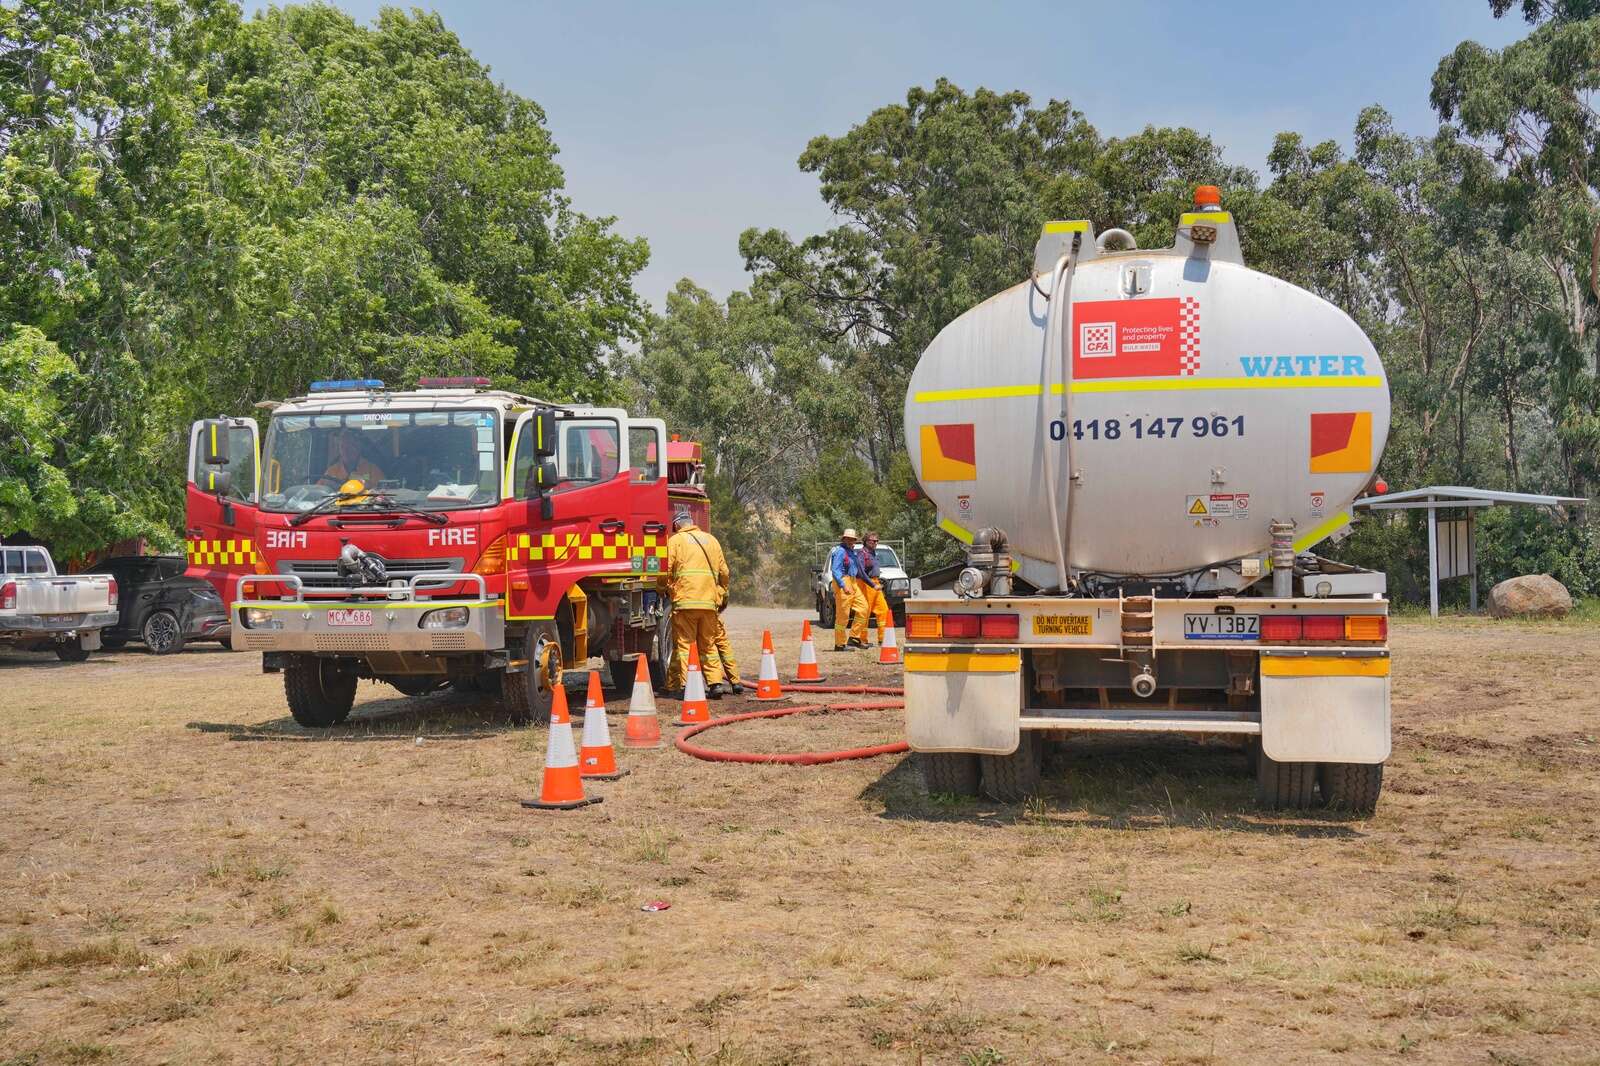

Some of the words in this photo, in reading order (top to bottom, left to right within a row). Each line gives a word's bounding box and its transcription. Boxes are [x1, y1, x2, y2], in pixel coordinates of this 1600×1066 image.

[1122, 326, 1157, 334] Protecting
[1136, 333, 1167, 341] property
[1087, 342, 1109, 351] CFA
[1240, 355, 1366, 377] WATER
[1049, 419, 1121, 441] 0418
[1129, 417, 1184, 439] 147
[1192, 415, 1245, 438] 961
[428, 527, 477, 546] FIRE
[328, 611, 346, 622] MCX
[1036, 616, 1045, 625] DO
[1046, 616, 1058, 625] NOT
[1059, 615, 1089, 624] OVERTAKE
[1038, 625, 1063, 634] TURNING
[1063, 625, 1089, 634] VEHICLE
